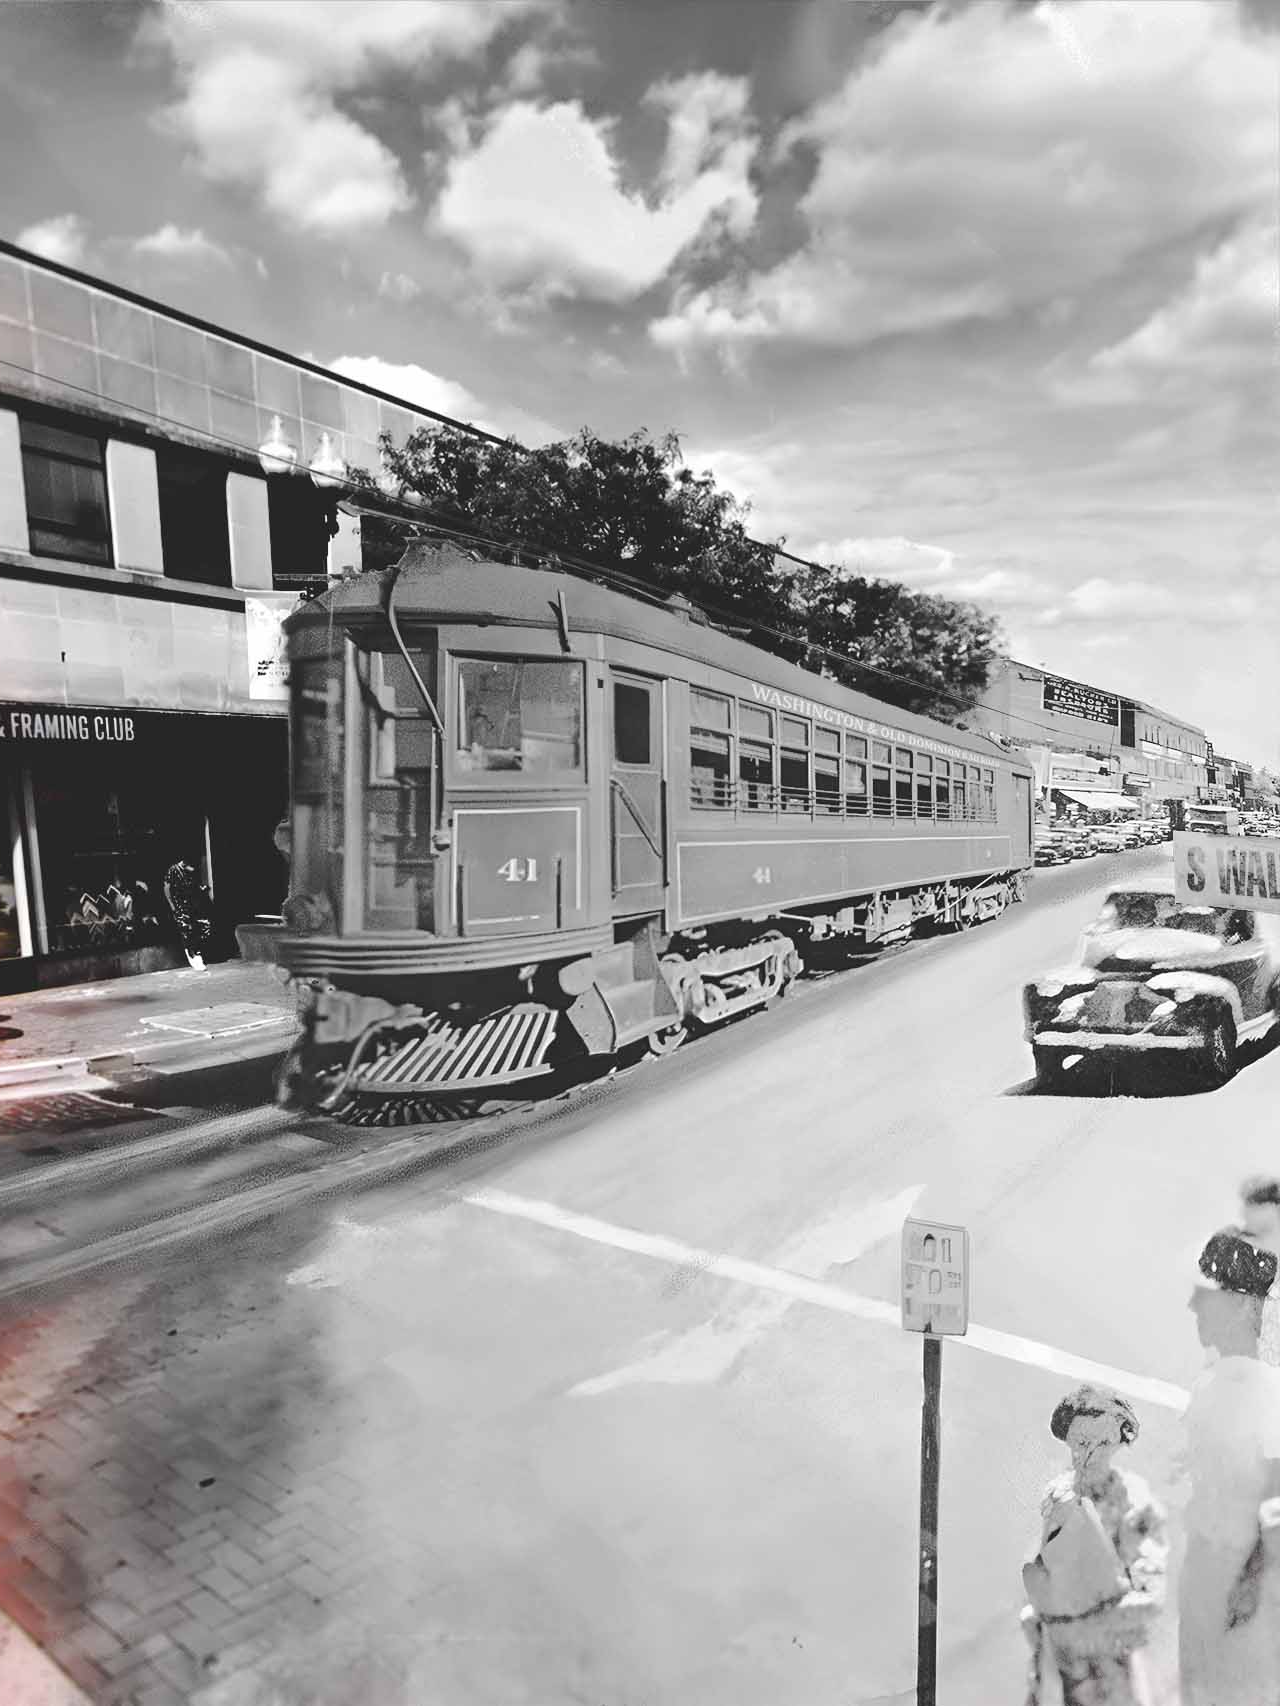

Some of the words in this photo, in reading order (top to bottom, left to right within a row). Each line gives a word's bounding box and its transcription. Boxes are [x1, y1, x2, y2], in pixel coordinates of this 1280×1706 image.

[10, 713, 90, 741] FRAMING
[94, 715, 135, 741] CLUB
[751, 683, 864, 731] WASHINGTON
[867, 722, 878, 735] &
[880, 726, 906, 743] OLD
[497, 857, 537, 882] 41
[752, 866, 771, 884] 41
[1187, 847, 1206, 891] S
